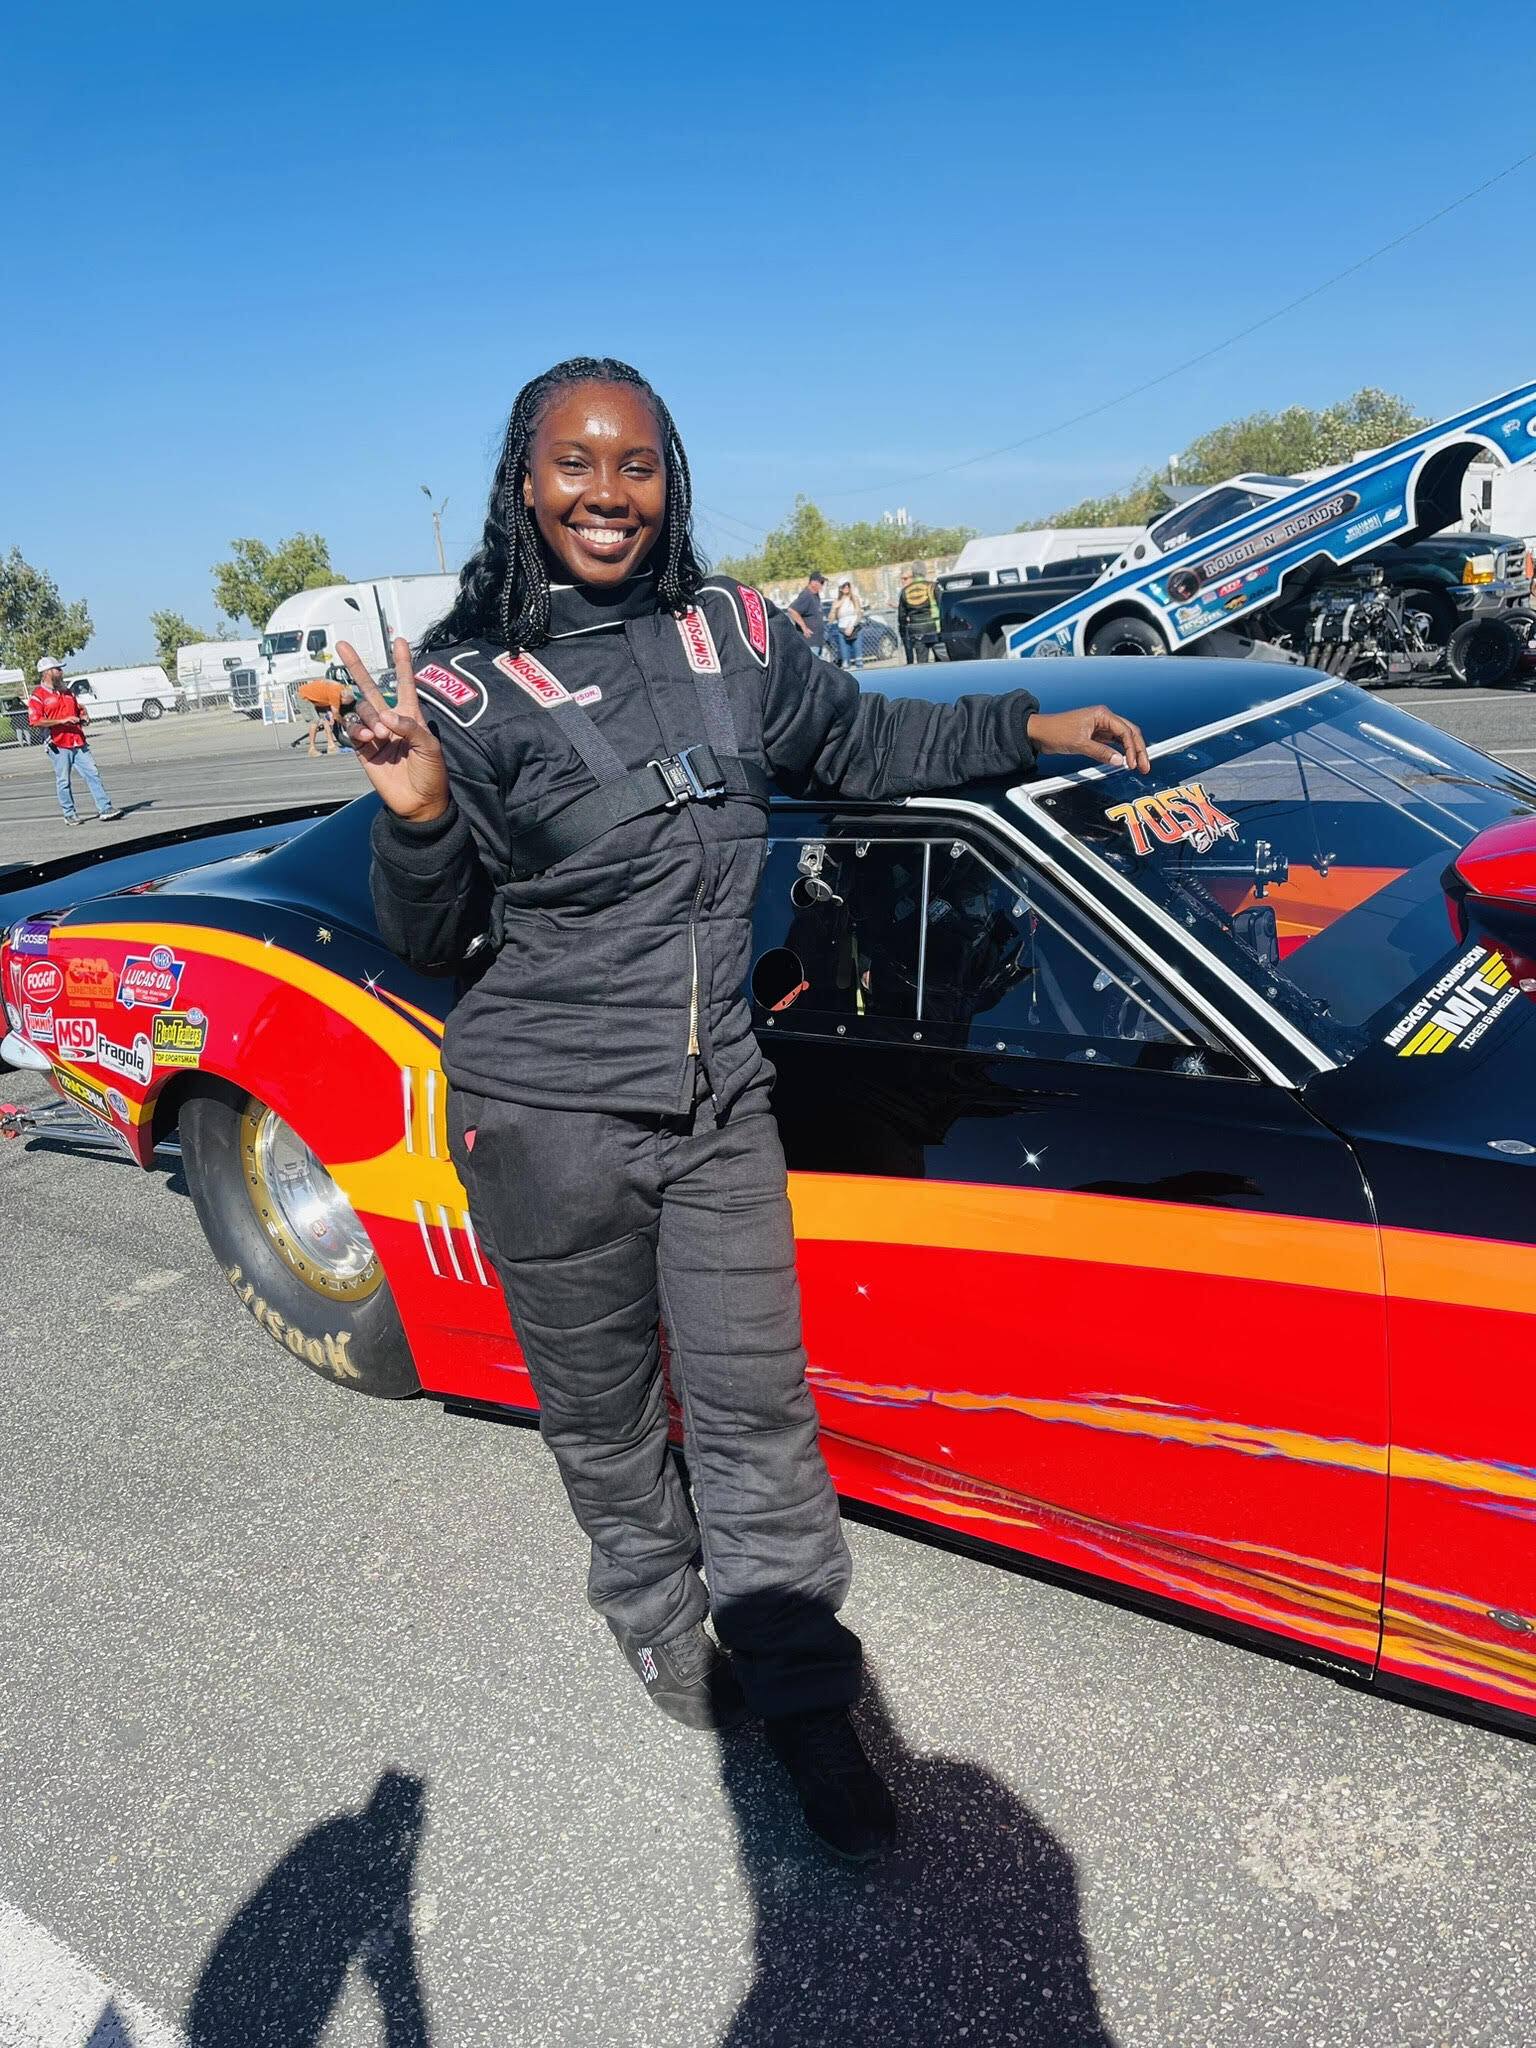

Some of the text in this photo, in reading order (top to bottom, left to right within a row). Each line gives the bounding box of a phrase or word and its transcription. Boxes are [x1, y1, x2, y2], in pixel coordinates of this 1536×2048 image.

[1203, 541, 1257, 577] ROUGH
[1262, 531, 1277, 548] N
[1282, 497, 1345, 538] READY
[742, 586, 765, 647] SIMPSON
[685, 612, 711, 666] SIMPSON
[419, 667, 471, 700] SIMPSON
[507, 656, 560, 698] SIMPSON
[20, 934, 48, 945] HOOSIER
[125, 969, 172, 990] LUCAS OIL
[1383, 945, 1488, 1047] MICKEY THOMPSON
[57, 1020, 95, 1047] MSD
[1458, 1021, 1488, 1050] TIRES
[1488, 986, 1521, 1019] WHEELS
[98, 1036, 144, 1071] Fragola
